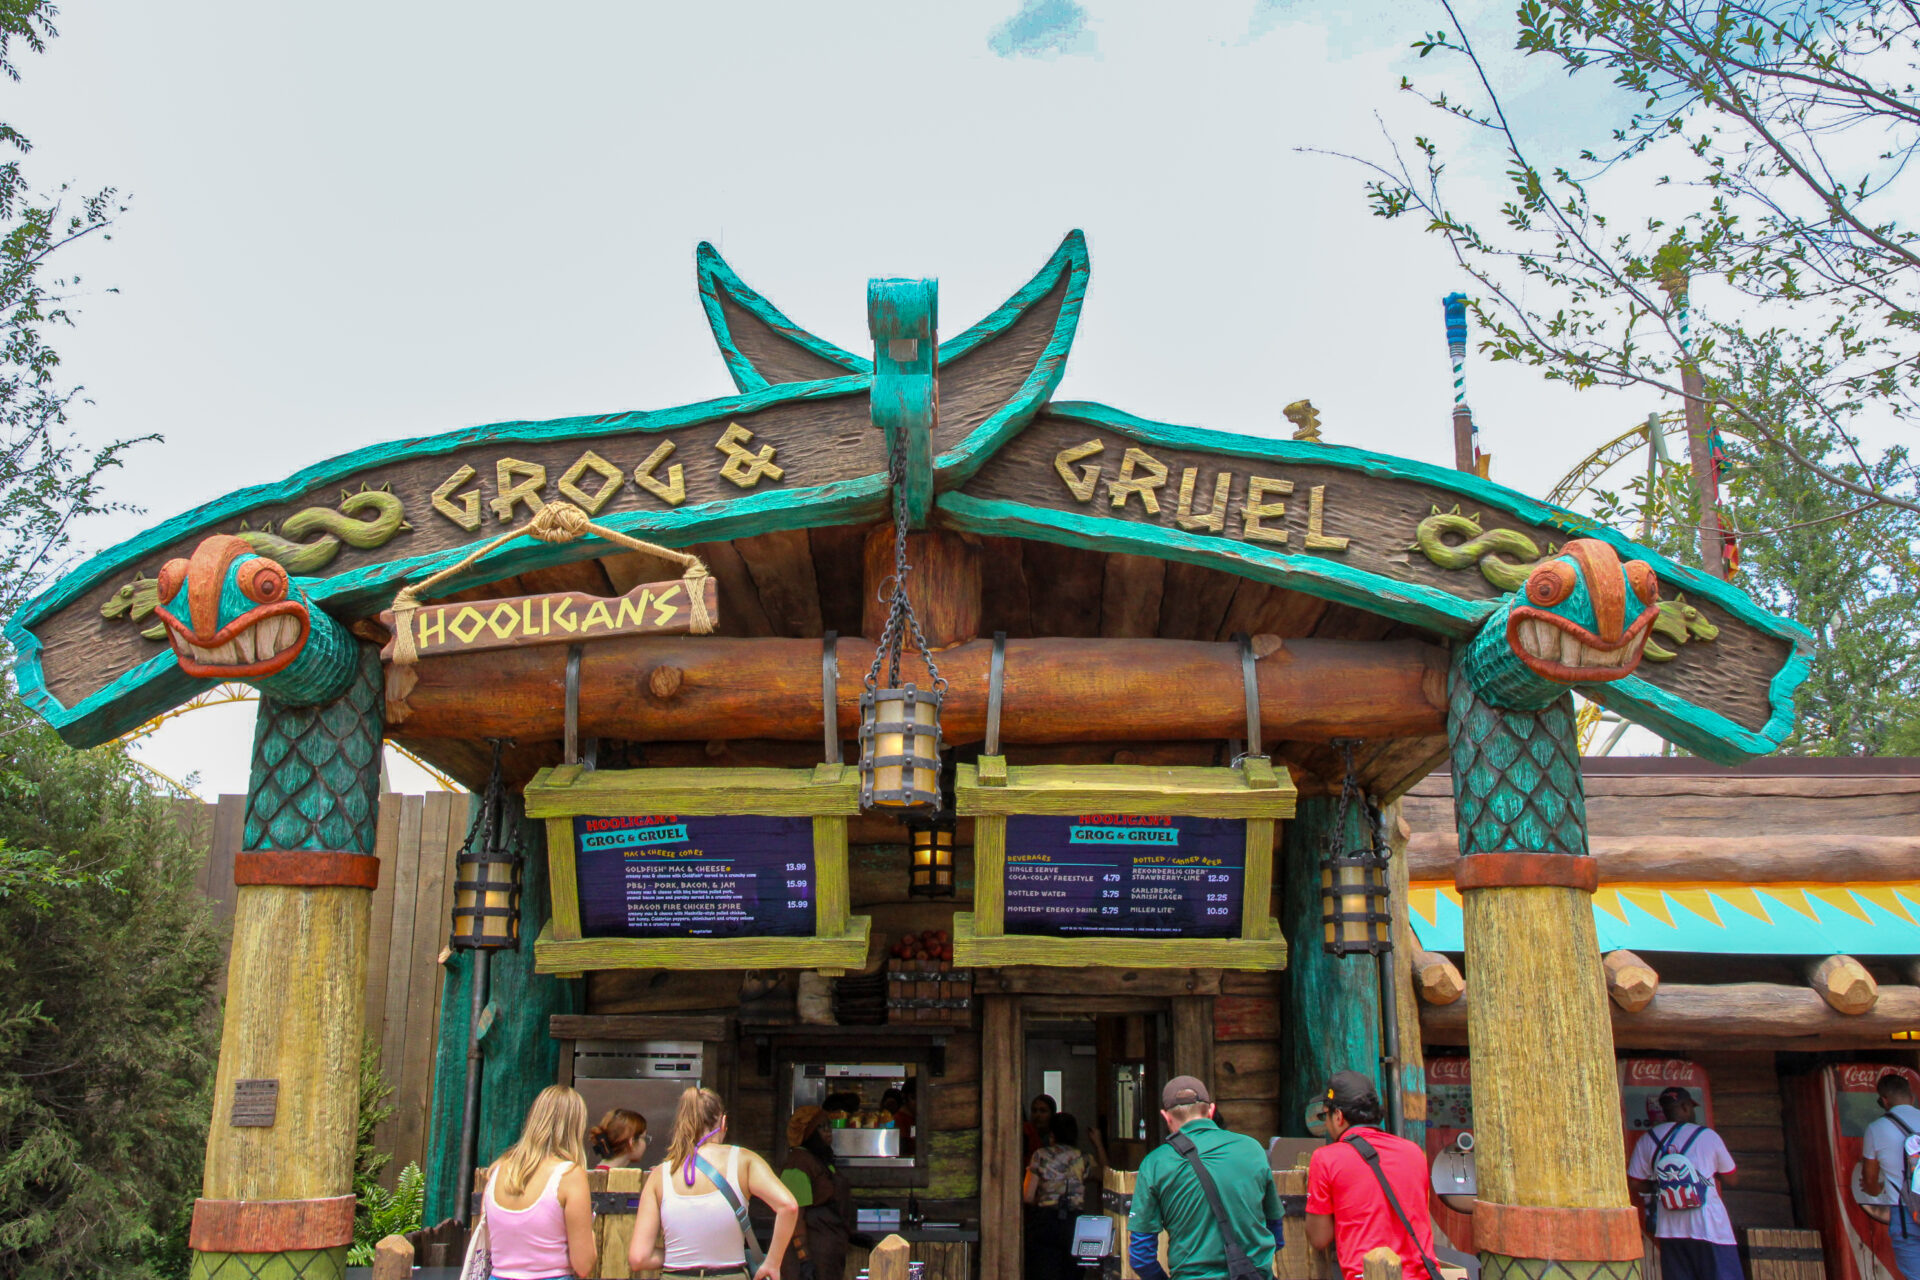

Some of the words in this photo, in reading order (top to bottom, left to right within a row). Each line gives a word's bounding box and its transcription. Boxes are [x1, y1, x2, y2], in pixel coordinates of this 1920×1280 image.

[431, 439, 686, 531] GROG
[715, 422, 784, 488] &
[1054, 438, 1350, 551] GRUEL
[418, 585, 682, 648] HOOLIGAN'S
[1079, 814, 1172, 826] HOOLIGAN'S
[586, 834, 626, 847] GROG
[638, 828, 684, 842] GRUEL
[1075, 830, 1114, 840] GROG
[1117, 832, 1125, 840] &
[1128, 831, 1173, 842] GRUEL
[647, 849, 676, 858] CHEESE
[679, 849, 703, 857] CONES
[1008, 854, 1051, 862] BEVERAGES
[1133, 856, 1166, 864] BOTTLED
[1172, 856, 1200, 865] CANNED
[1202, 856, 1222, 866] BEER
[1103, 874, 1120, 882] 4.79
[1208, 874, 1230, 882] 12.50
[786, 880, 807, 888] 15.99
[1102, 890, 1120, 898] 3.75
[1206, 893, 1228, 902] 12.25
[1102, 906, 1119, 914] 5.75
[1207, 907, 1228, 915] 10.50
